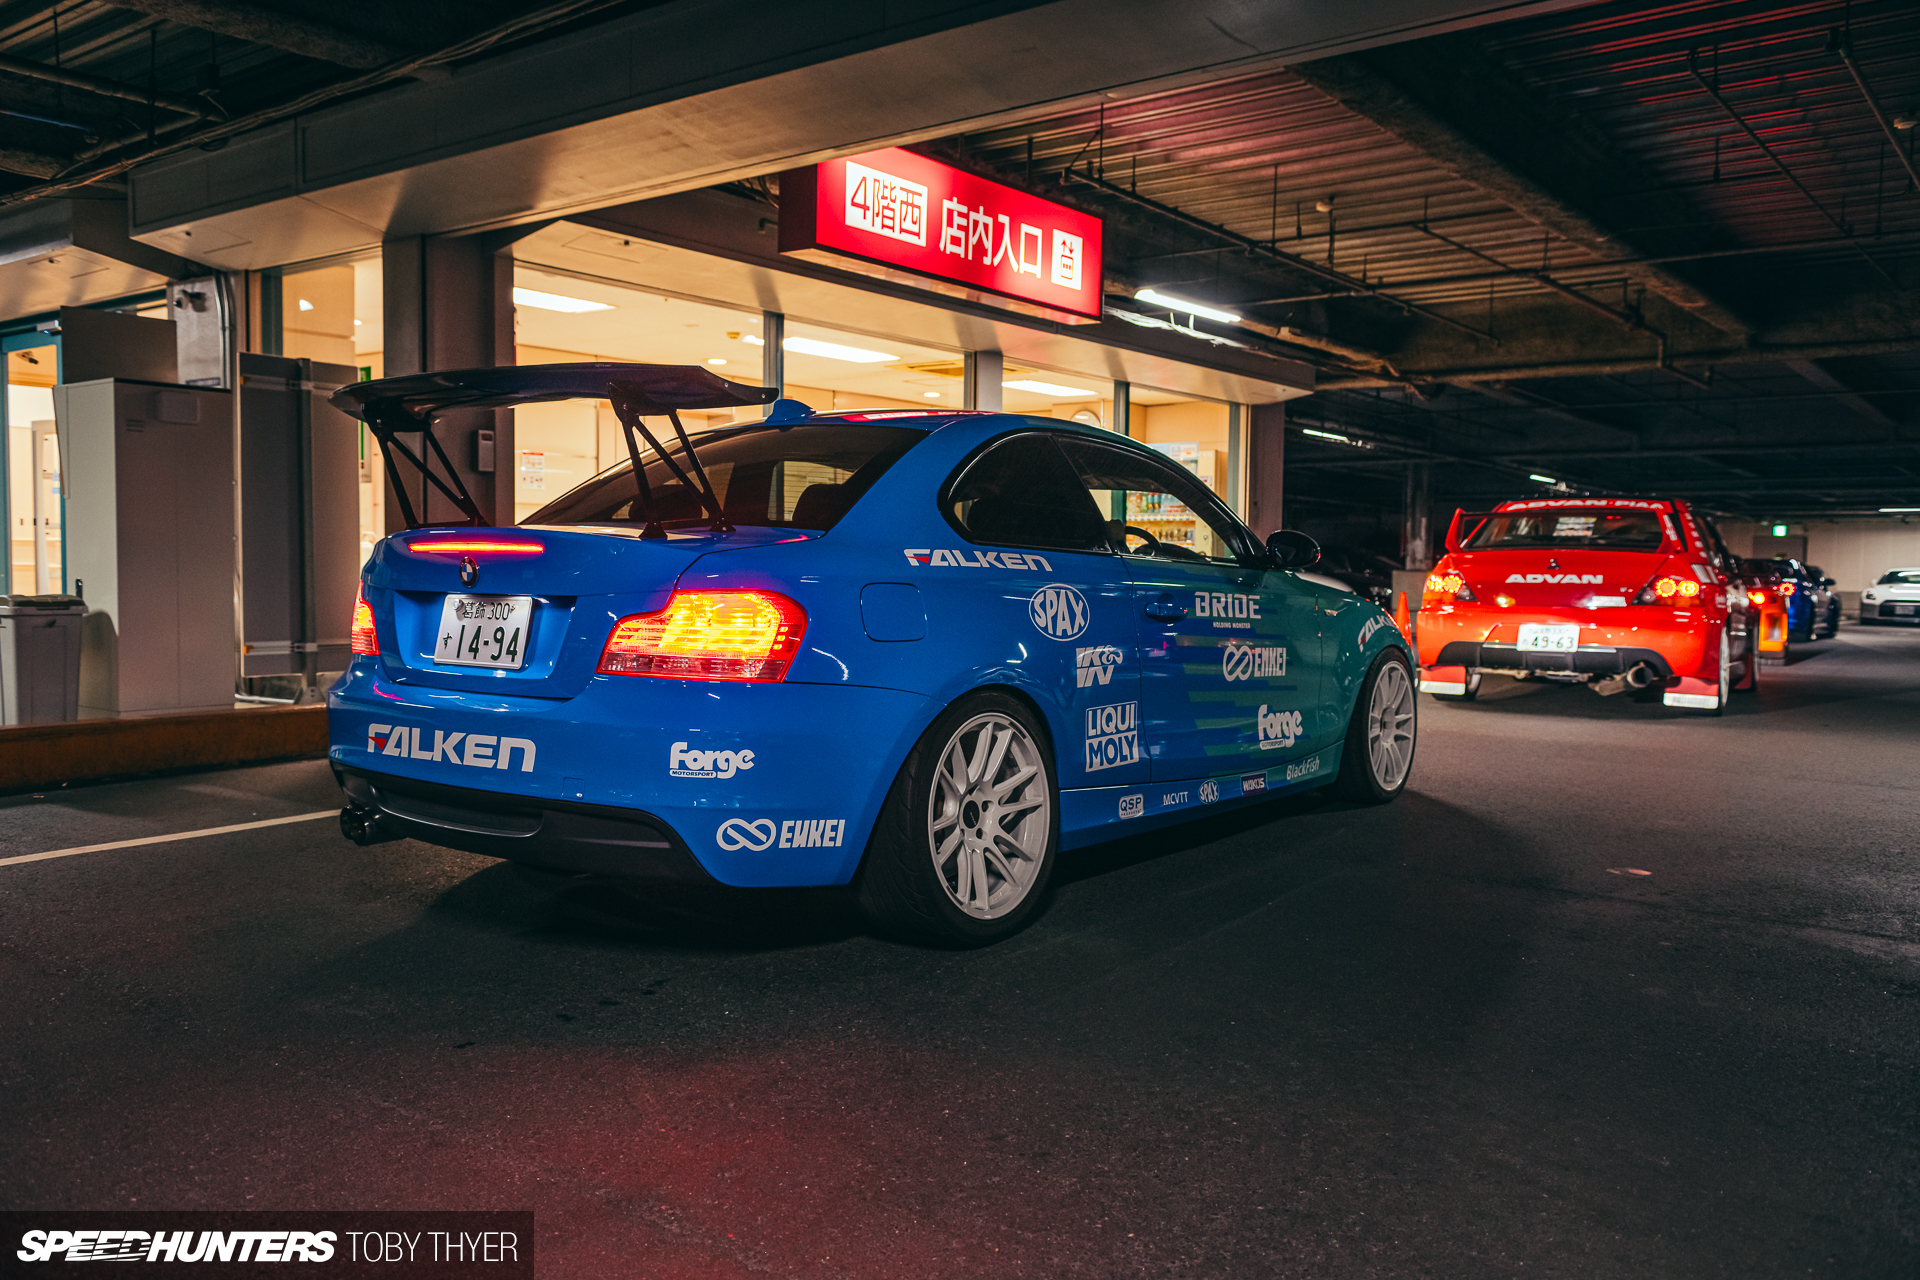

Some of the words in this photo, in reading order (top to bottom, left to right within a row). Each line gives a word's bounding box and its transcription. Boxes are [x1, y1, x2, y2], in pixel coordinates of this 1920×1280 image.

[850, 176, 923, 240] 4階西
[939, 197, 1043, 279] 店内入口
[1506, 500, 1607, 511] ADVAN
[904, 549, 1053, 571] FALKEN
[1505, 574, 1603, 584] ADVAN
[462, 601, 486, 619] 葛飾
[487, 602, 511, 621] 300
[1034, 589, 1086, 636] SPAX
[1195, 591, 1261, 619] BRIDE
[456, 624, 520, 662] 14-94
[1358, 615, 1398, 653] FALK
[1531, 636, 1574, 649] 49-63
[1254, 647, 1287, 677] ENKEI
[1088, 704, 1135, 736] LIQUI
[367, 723, 536, 772] FALKEN
[1088, 734, 1136, 768] MOLY
[1120, 797, 1142, 812] QSP
[1163, 791, 1188, 805] MCVTT
[1200, 782, 1218, 803] SPAX
[778, 819, 846, 848] ENKEI
